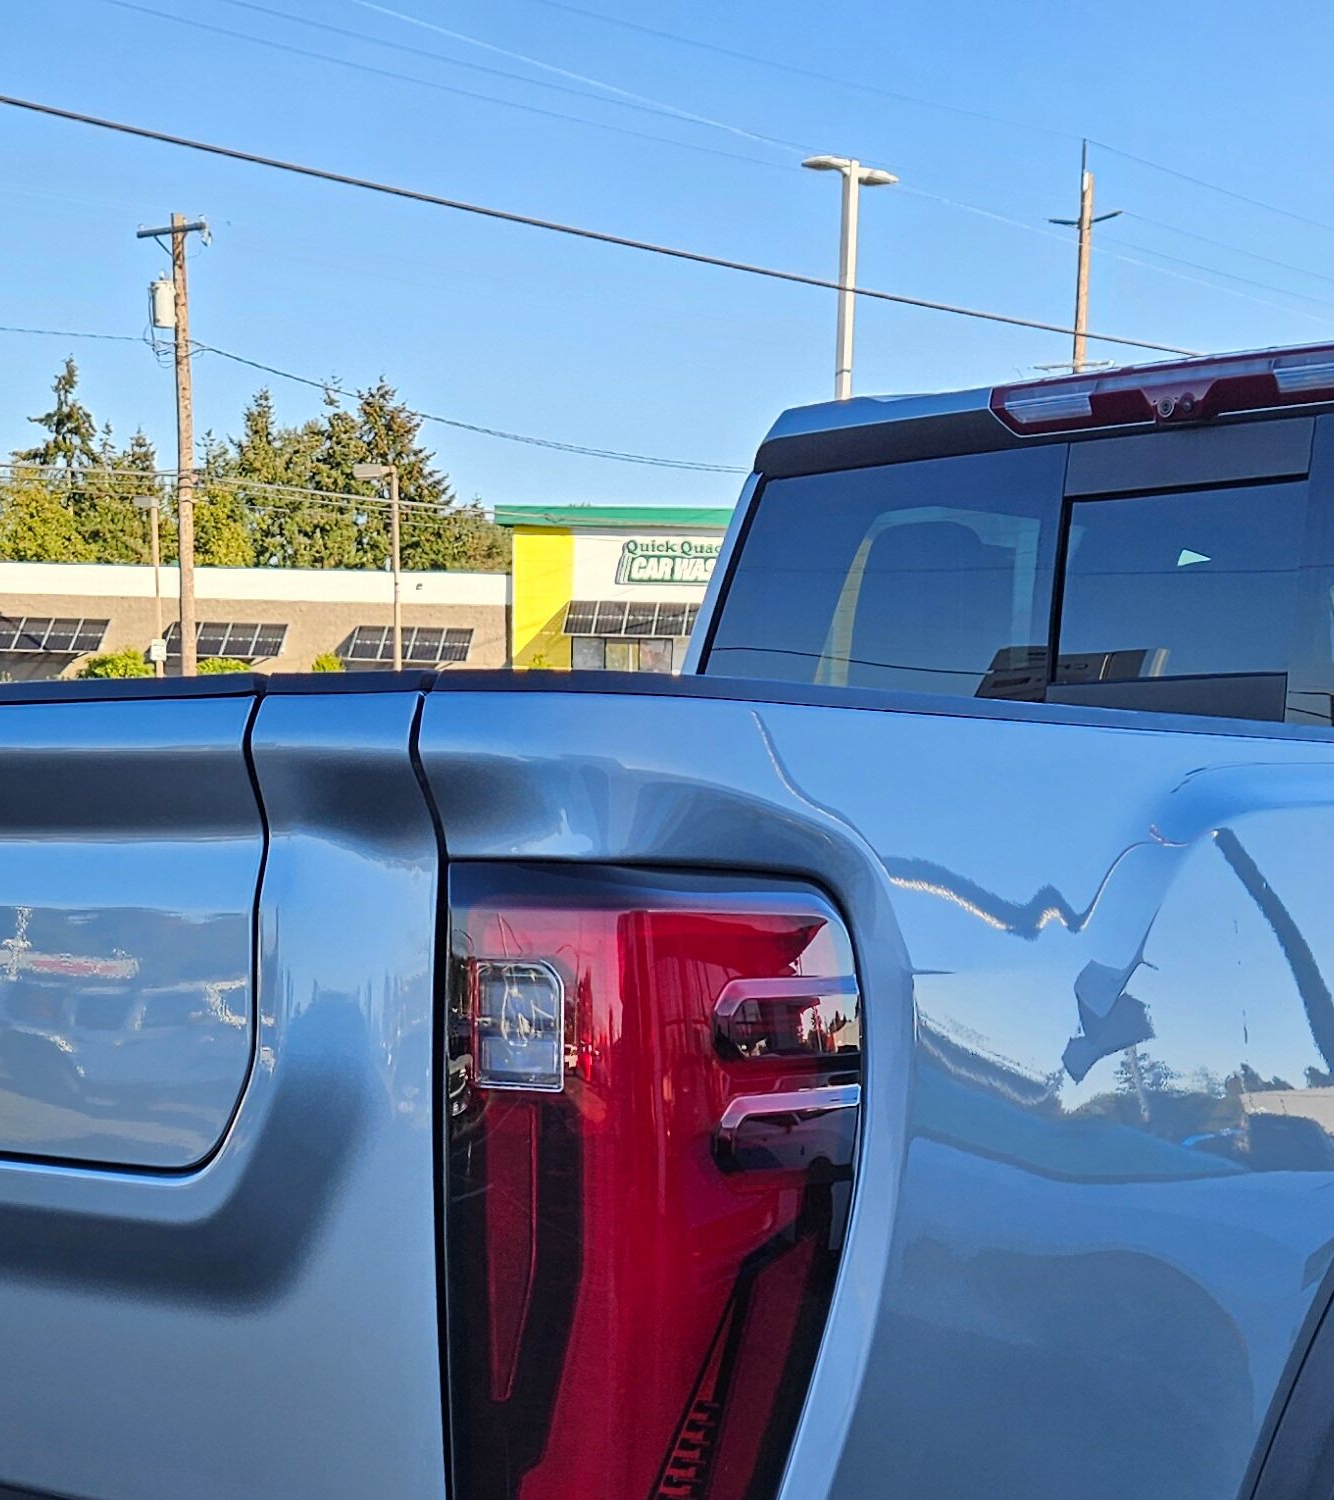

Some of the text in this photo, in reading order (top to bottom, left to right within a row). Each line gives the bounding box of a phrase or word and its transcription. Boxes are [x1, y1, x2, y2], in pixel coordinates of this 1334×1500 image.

[627, 540, 722, 555] Quick Quac
[630, 556, 717, 580] CAR WAS
